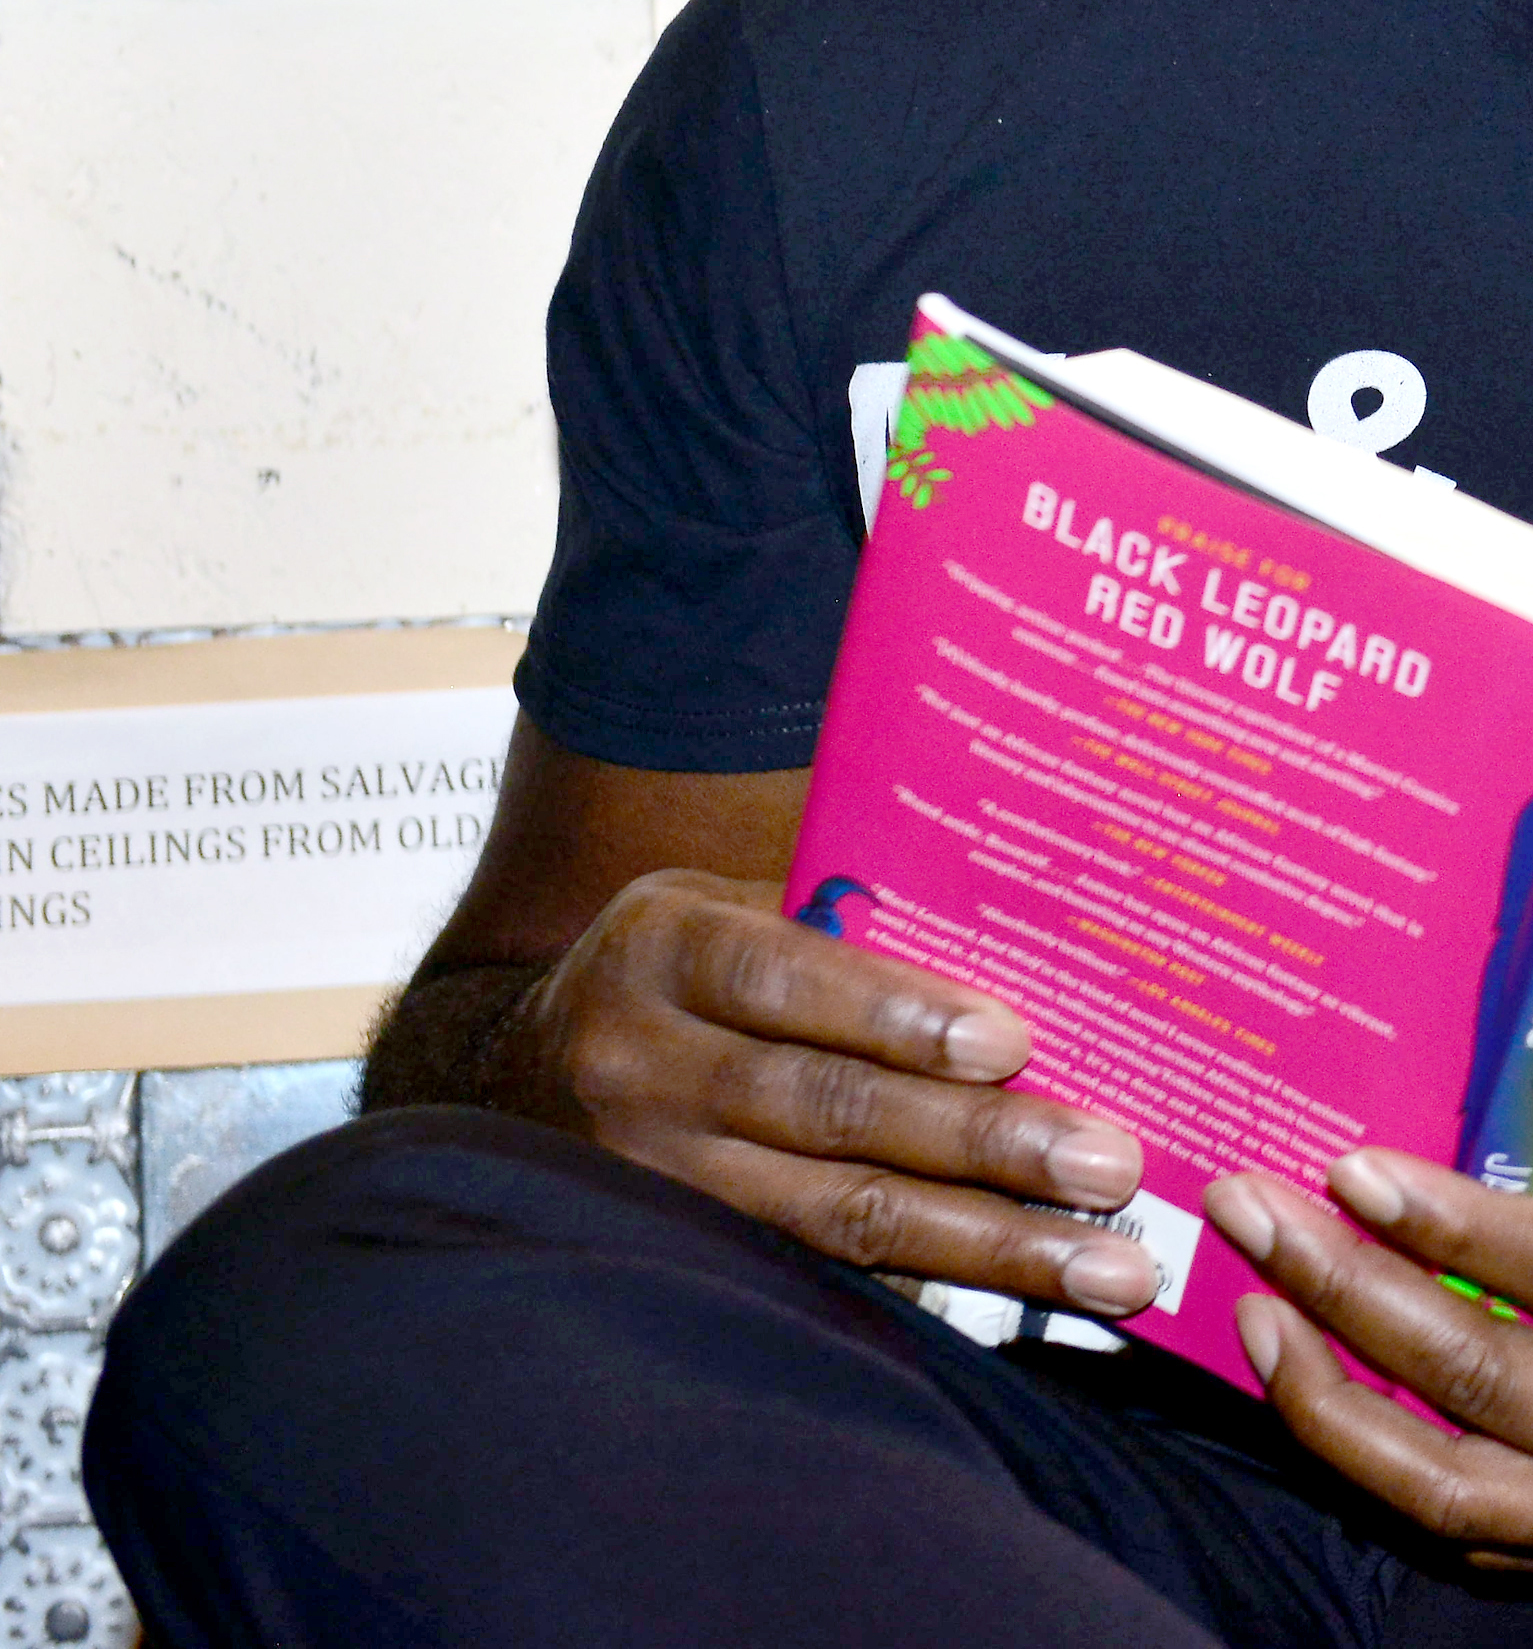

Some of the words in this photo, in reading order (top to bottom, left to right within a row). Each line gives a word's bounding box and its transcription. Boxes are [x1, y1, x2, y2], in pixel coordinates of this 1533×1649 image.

[1021, 480, 1189, 597] BLACK
[1202, 567, 1432, 698] LEOPARD
[1084, 572, 1186, 650] RED
[1204, 623, 1343, 712] WOLF
[0, 781, 28, 819] S
[43, 775, 169, 815] MADE
[183, 766, 305, 807] FROM
[50, 825, 247, 872] CEILINGS
[262, 818, 382, 860] FROM
[399, 813, 482, 851] OLD
[0, 890, 91, 929] NGS
